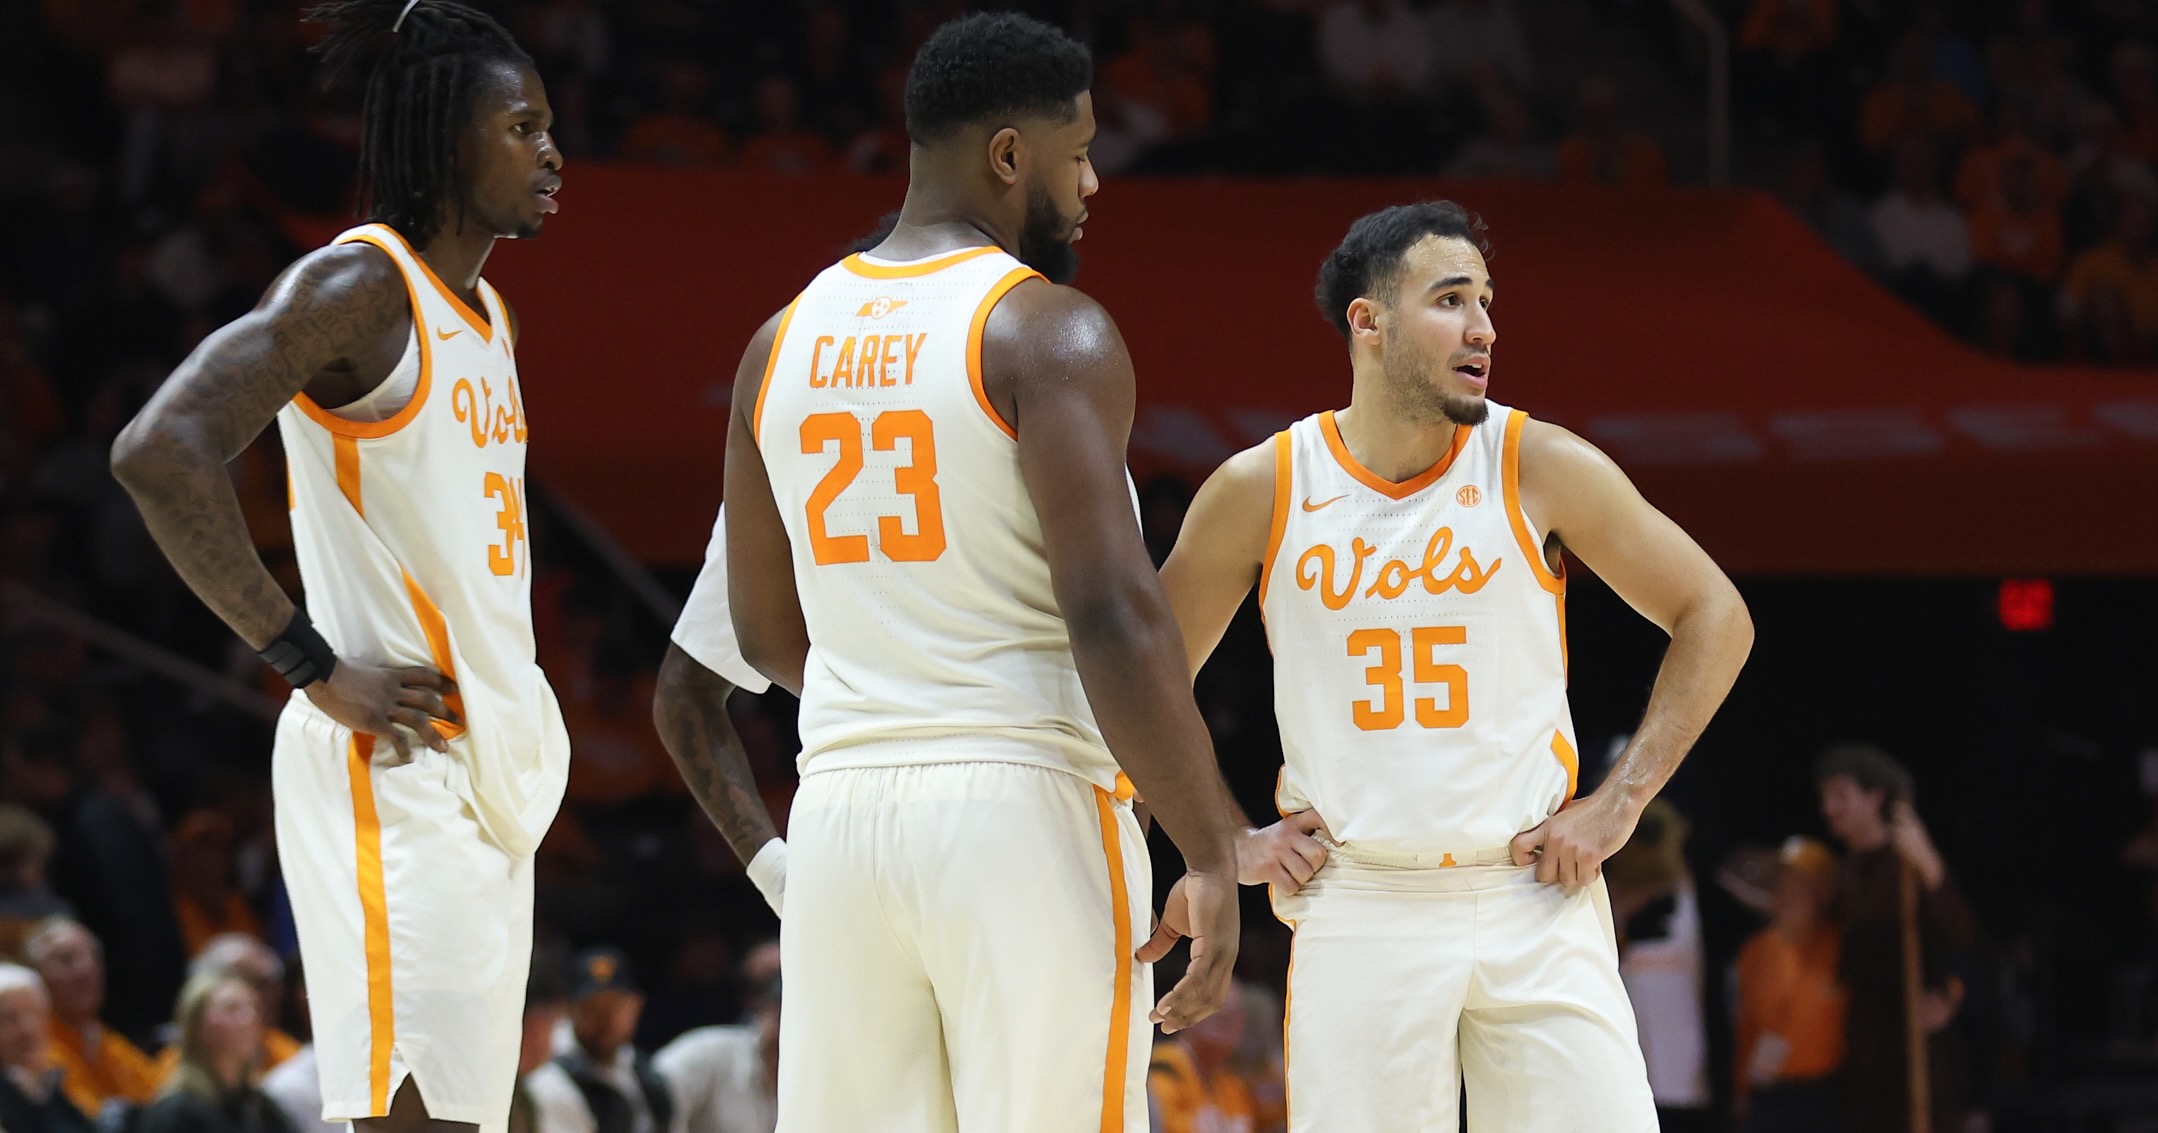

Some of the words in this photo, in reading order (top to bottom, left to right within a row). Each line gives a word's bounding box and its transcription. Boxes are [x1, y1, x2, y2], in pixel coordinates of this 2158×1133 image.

[809, 333, 927, 388] CAREY
[799, 409, 947, 566] 23
[1458, 487, 1479, 506] SEC
[1296, 526, 1502, 611] Vols
[1346, 625, 1469, 731] 35
